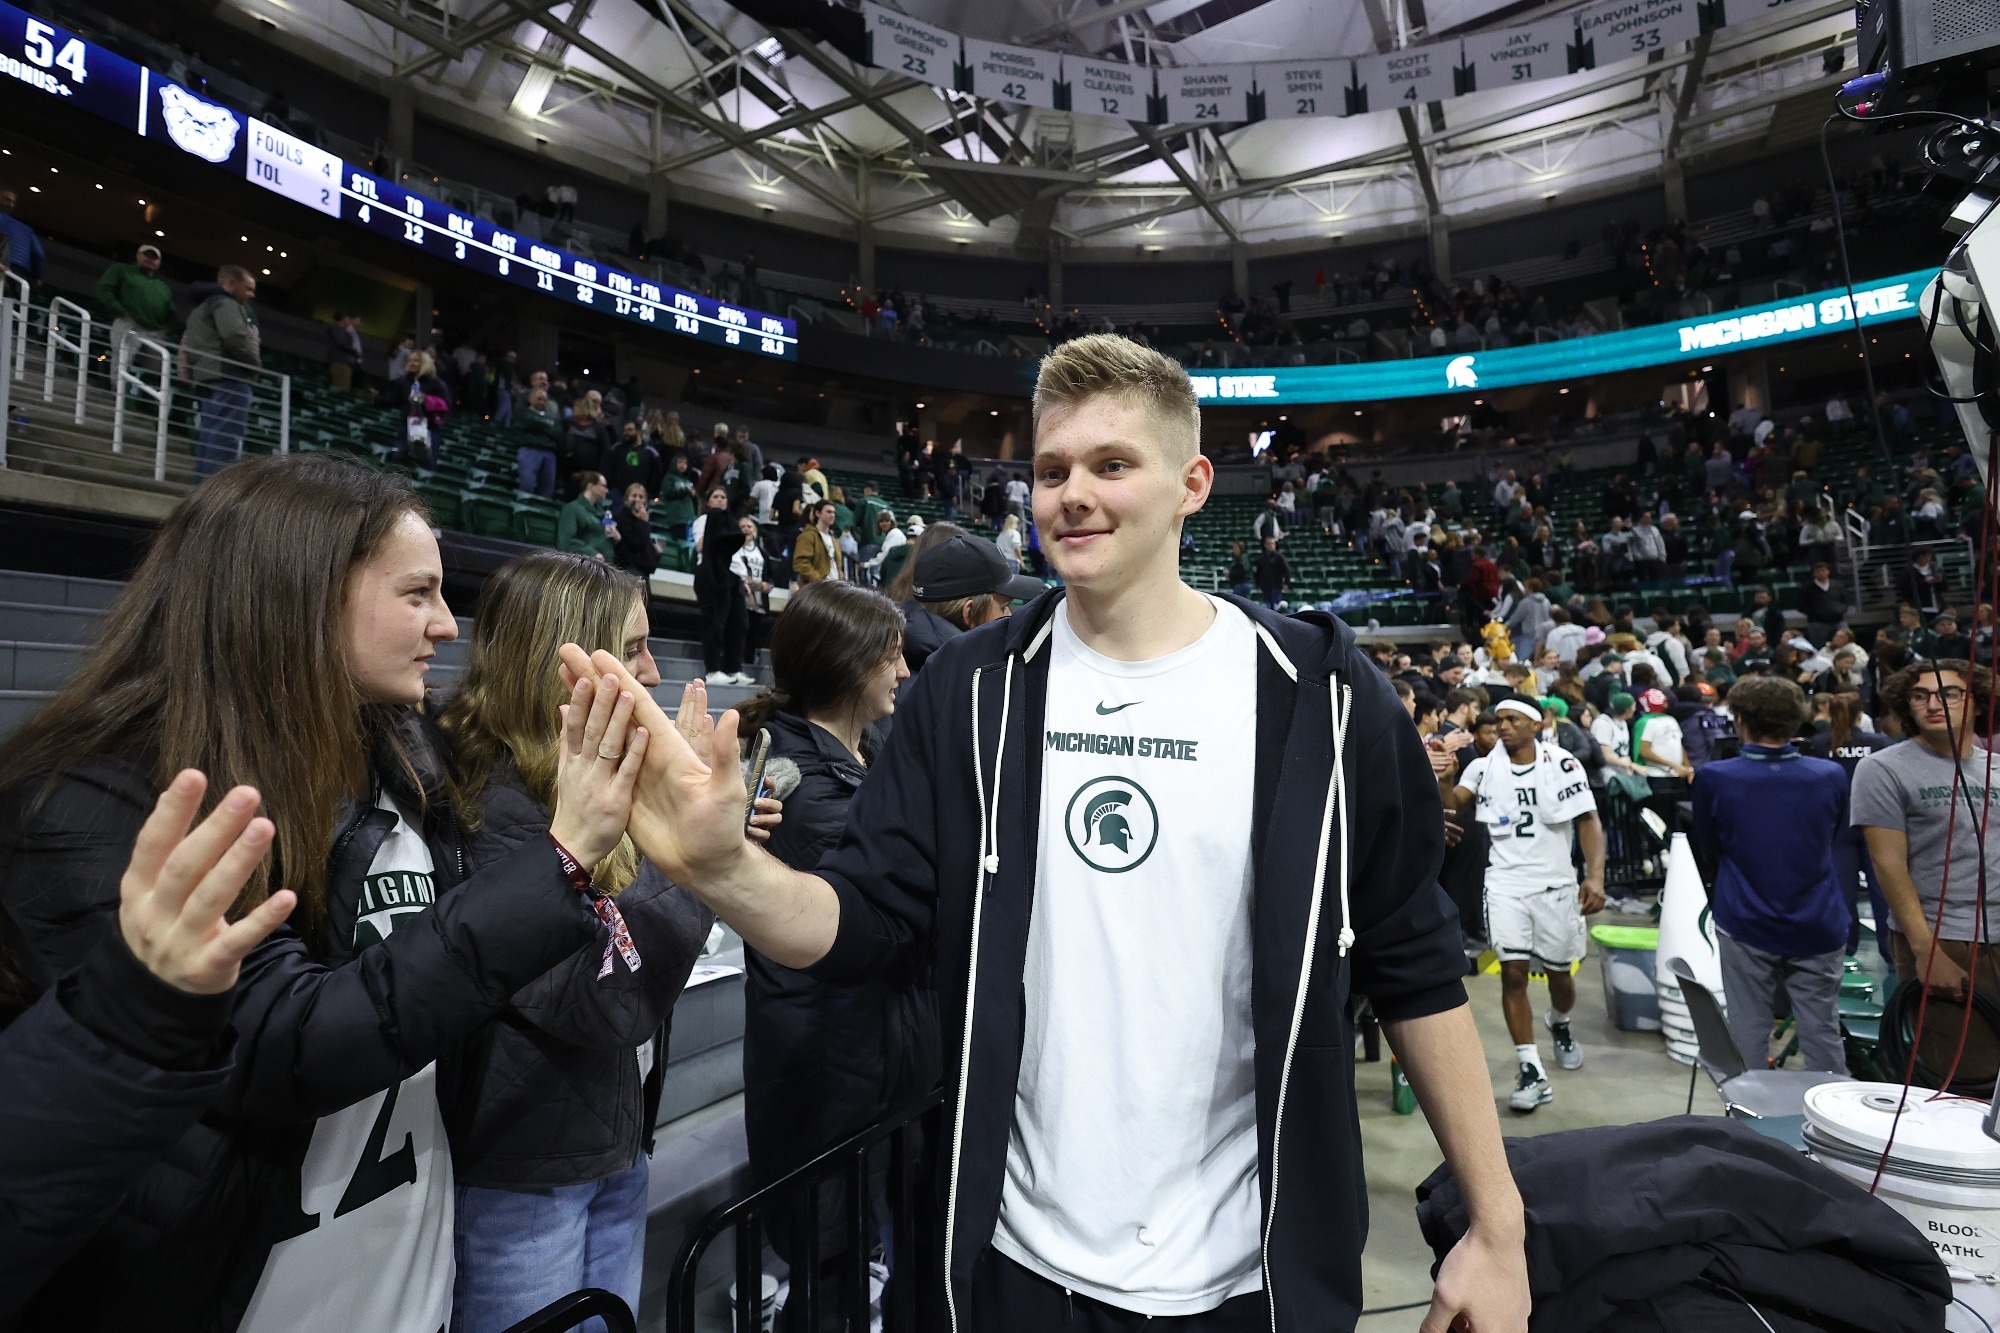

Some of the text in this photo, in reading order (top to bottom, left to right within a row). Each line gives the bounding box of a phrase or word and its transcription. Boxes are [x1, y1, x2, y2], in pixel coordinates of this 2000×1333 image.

[1583, 4, 1639, 29] EARVIN
[1608, 3, 1682, 36] JOHNSON
[877, 14, 949, 48] DRAYMOND
[1506, 33, 1532, 47] JAY
[1631, 28, 1661, 52] 33
[24, 18, 87, 84] 54
[893, 33, 935, 56] GREEN
[1490, 43, 1549, 62] VINCENT
[902, 54, 926, 74] 23
[990, 51, 1035, 66] MORRIS
[1387, 53, 1429, 70] SCOTT
[982, 61, 1044, 80] PETERSON
[1085, 66, 1131, 82] MATEEN
[1183, 74, 1228, 86] SHAWN
[1285, 70, 1322, 81] STEVE
[1388, 66, 1431, 83] SKILES
[1511, 63, 1532, 80] 31
[1002, 83, 1026, 100] 42
[1083, 78, 1134, 96] CLEAVES
[1180, 86, 1232, 98] RESPERT
[1287, 82, 1323, 93] SMITH
[1404, 85, 1418, 100] 4
[1101, 98, 1119, 114] 12
[1195, 103, 1219, 118] 24
[1297, 99, 1315, 114] 21
[256, 131, 330, 177] FOULS 4
[255, 159, 330, 205] TOL 2
[352, 173, 379, 200] STL
[405, 195, 424, 218] TO
[448, 213, 474, 238] BLK
[492, 231, 517, 253] AST
[674, 293, 698, 313] FT%
[358, 204, 371, 223] 4
[404, 221, 424, 244] 12
[537, 271, 554, 291] 11
[1678, 283, 1916, 352] MICHIGAN STATE
[1219, 376, 1280, 398] STATE
[1045, 730, 1199, 761] MICHIGAN STATE
[1829, 746, 1872, 758] OLICE
[1515, 811, 1535, 837] 2
[358, 874, 436, 916] IGAN
